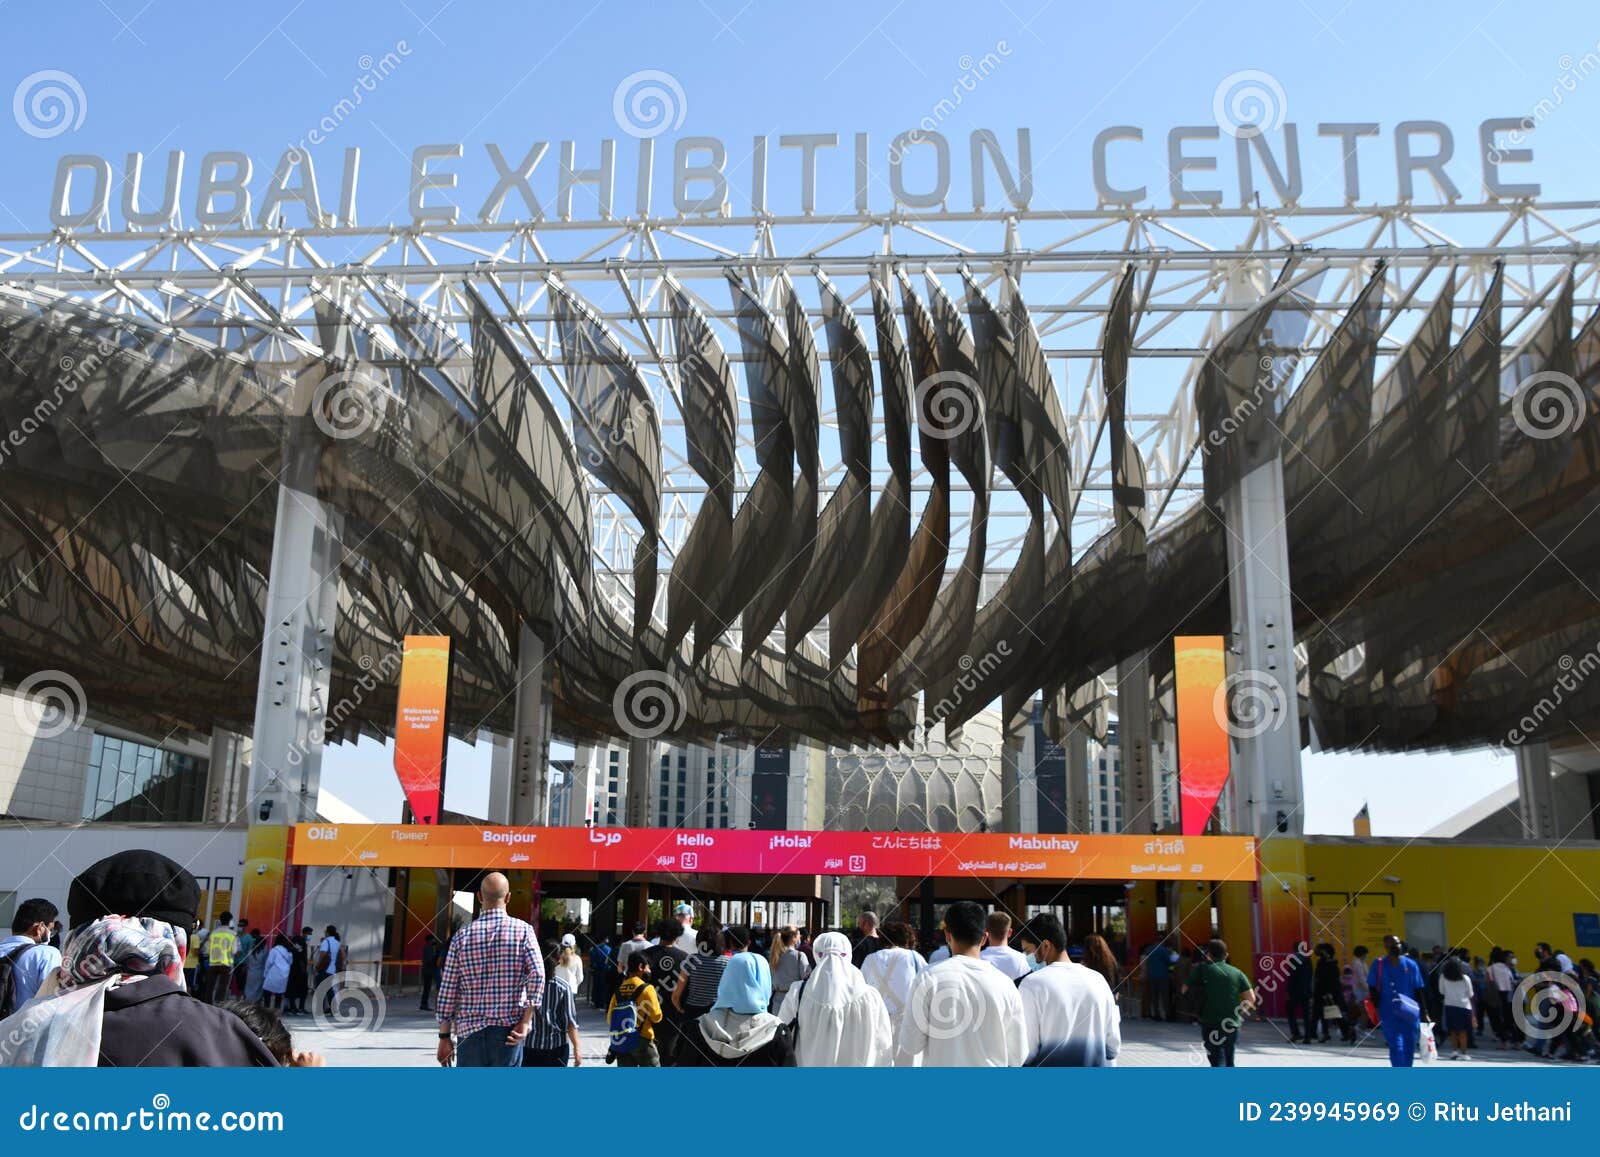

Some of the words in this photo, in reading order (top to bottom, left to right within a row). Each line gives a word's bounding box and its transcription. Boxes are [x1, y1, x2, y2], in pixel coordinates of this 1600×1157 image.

[50, 146, 361, 228] DUBAI
[408, 128, 1035, 226] EXHIBITION
[1092, 117, 1542, 210] CENTRE
[405, 715, 420, 723] Expo
[307, 827, 338, 841] Olá!
[391, 830, 429, 843] Привет
[482, 830, 537, 845] Bonjour
[676, 834, 714, 846] Hello
[769, 835, 812, 849] ¡Hola!
[1009, 837, 1079, 853] Mabuhay
